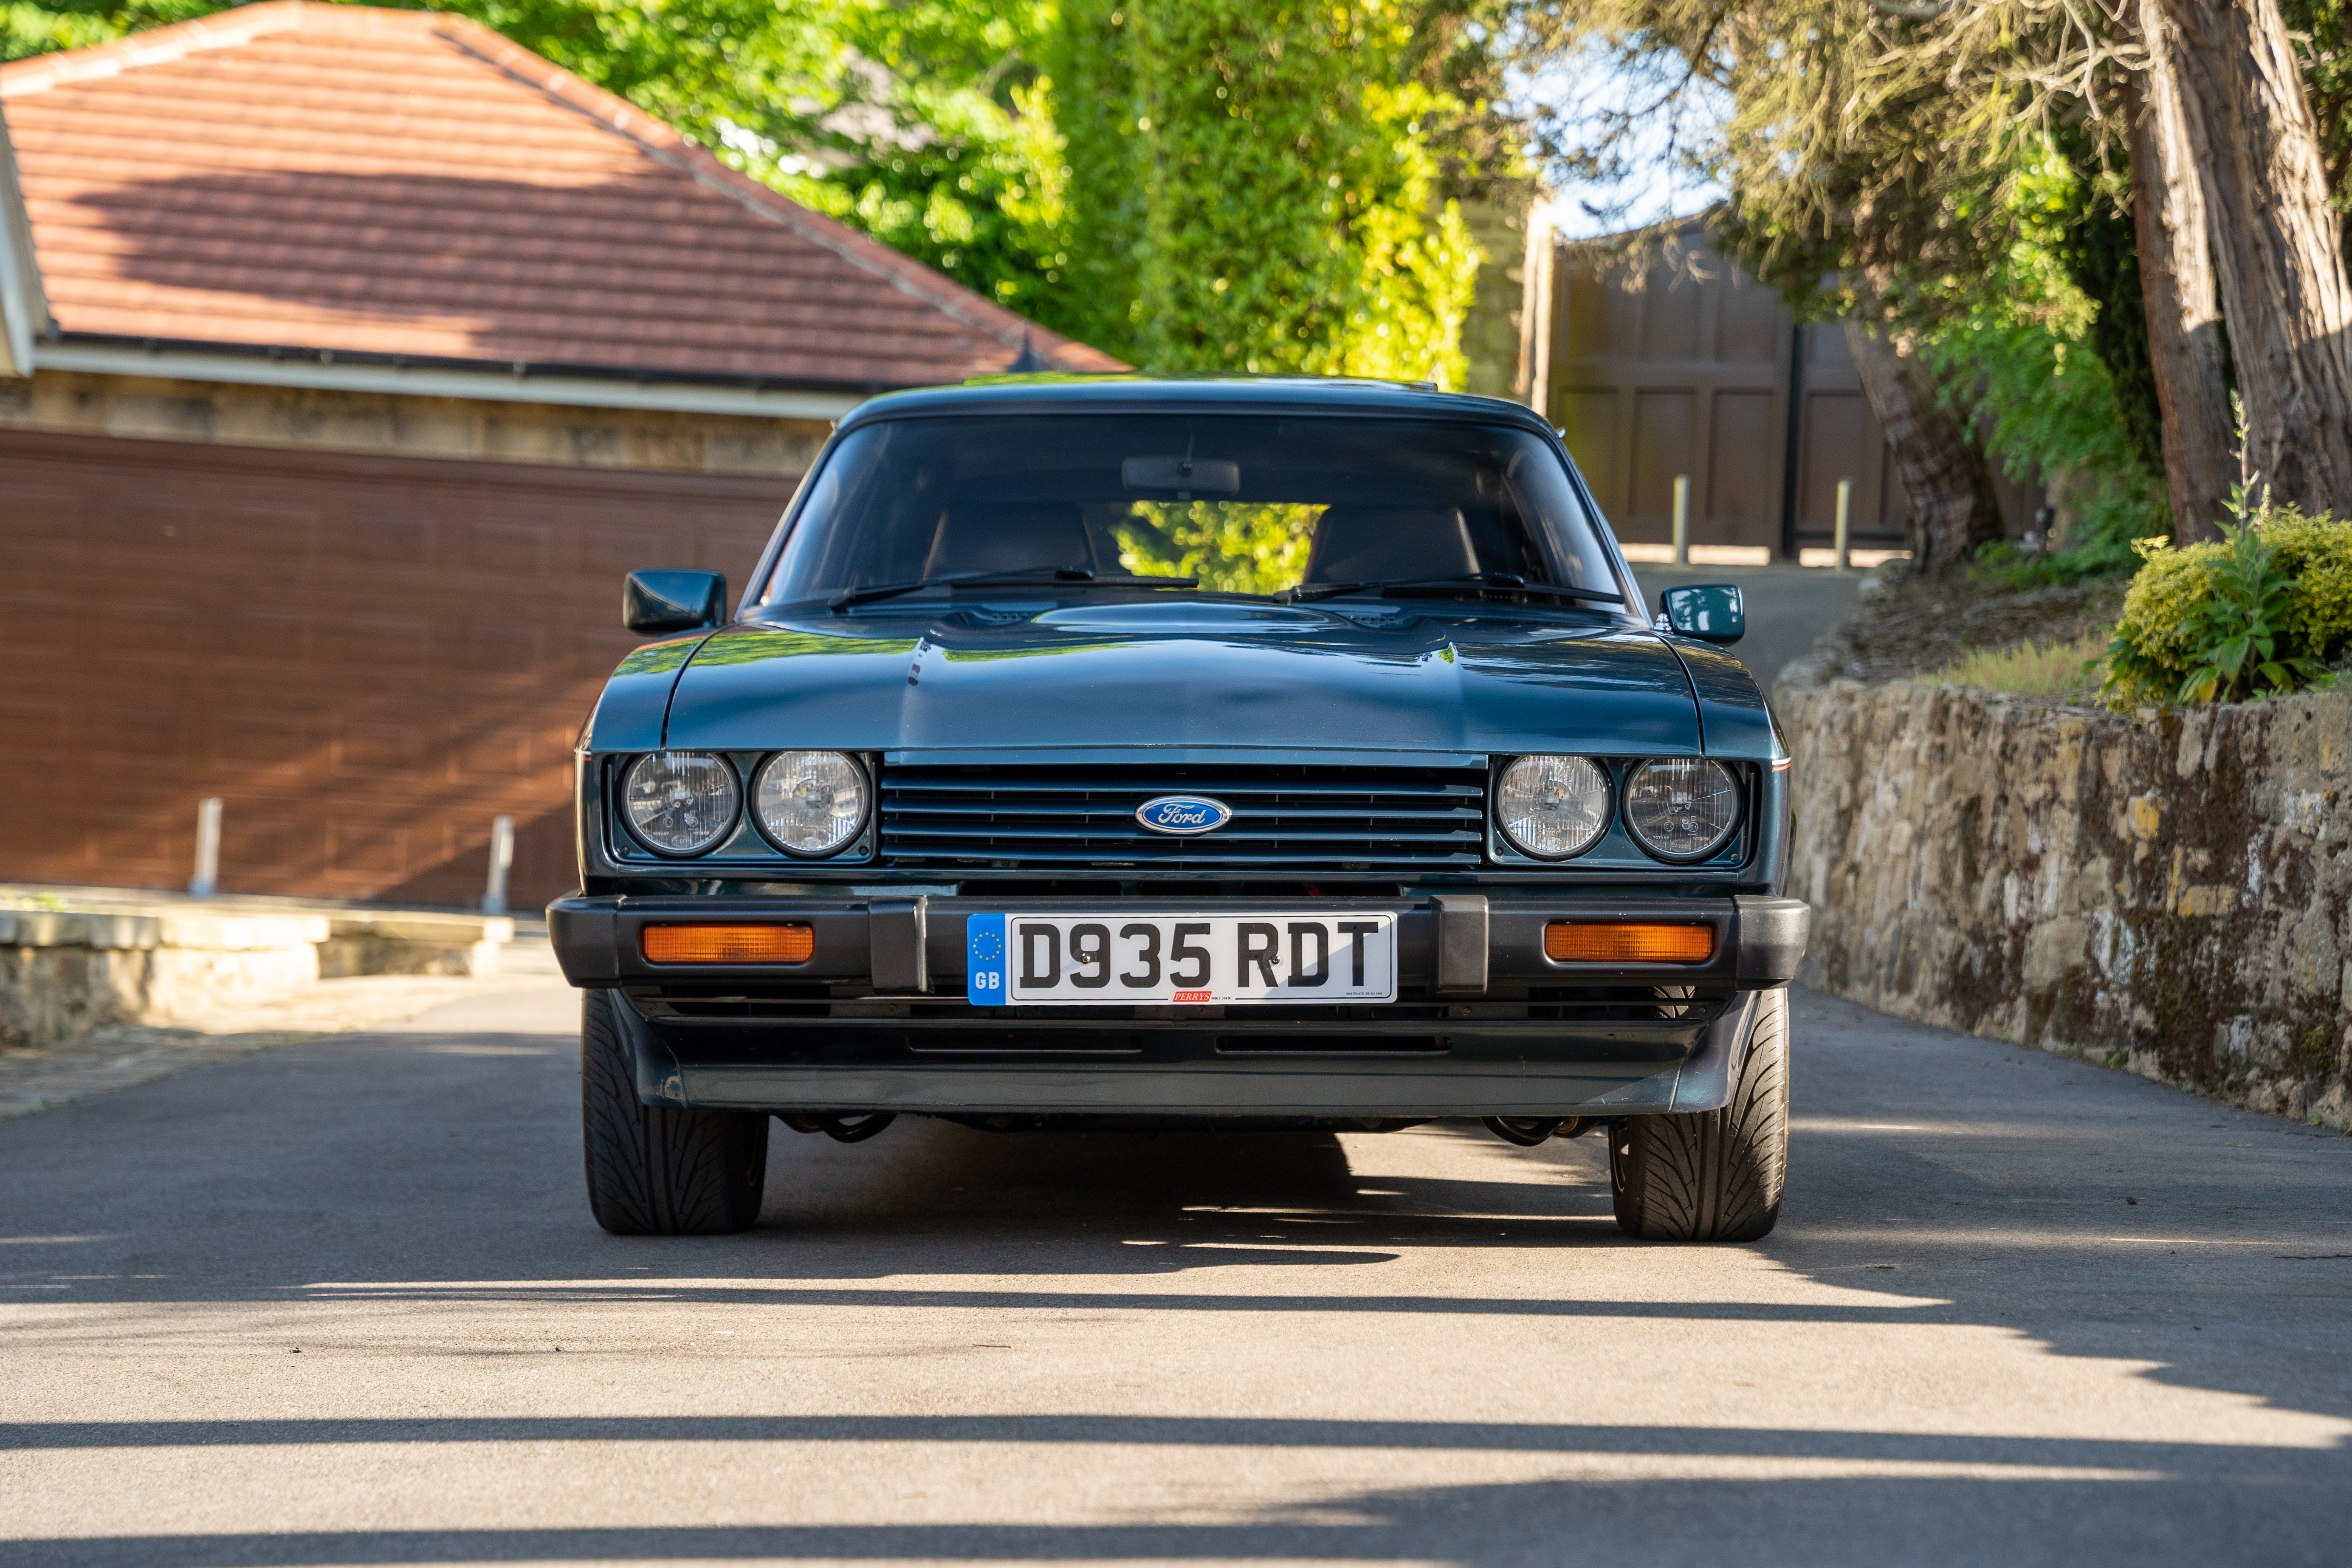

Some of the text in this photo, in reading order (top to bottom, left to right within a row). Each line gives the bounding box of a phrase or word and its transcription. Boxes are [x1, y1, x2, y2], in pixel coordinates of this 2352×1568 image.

[1158, 804, 1206, 823] Ford
[1019, 922, 1379, 988] D935 RDT
[976, 972, 999, 989] GB
